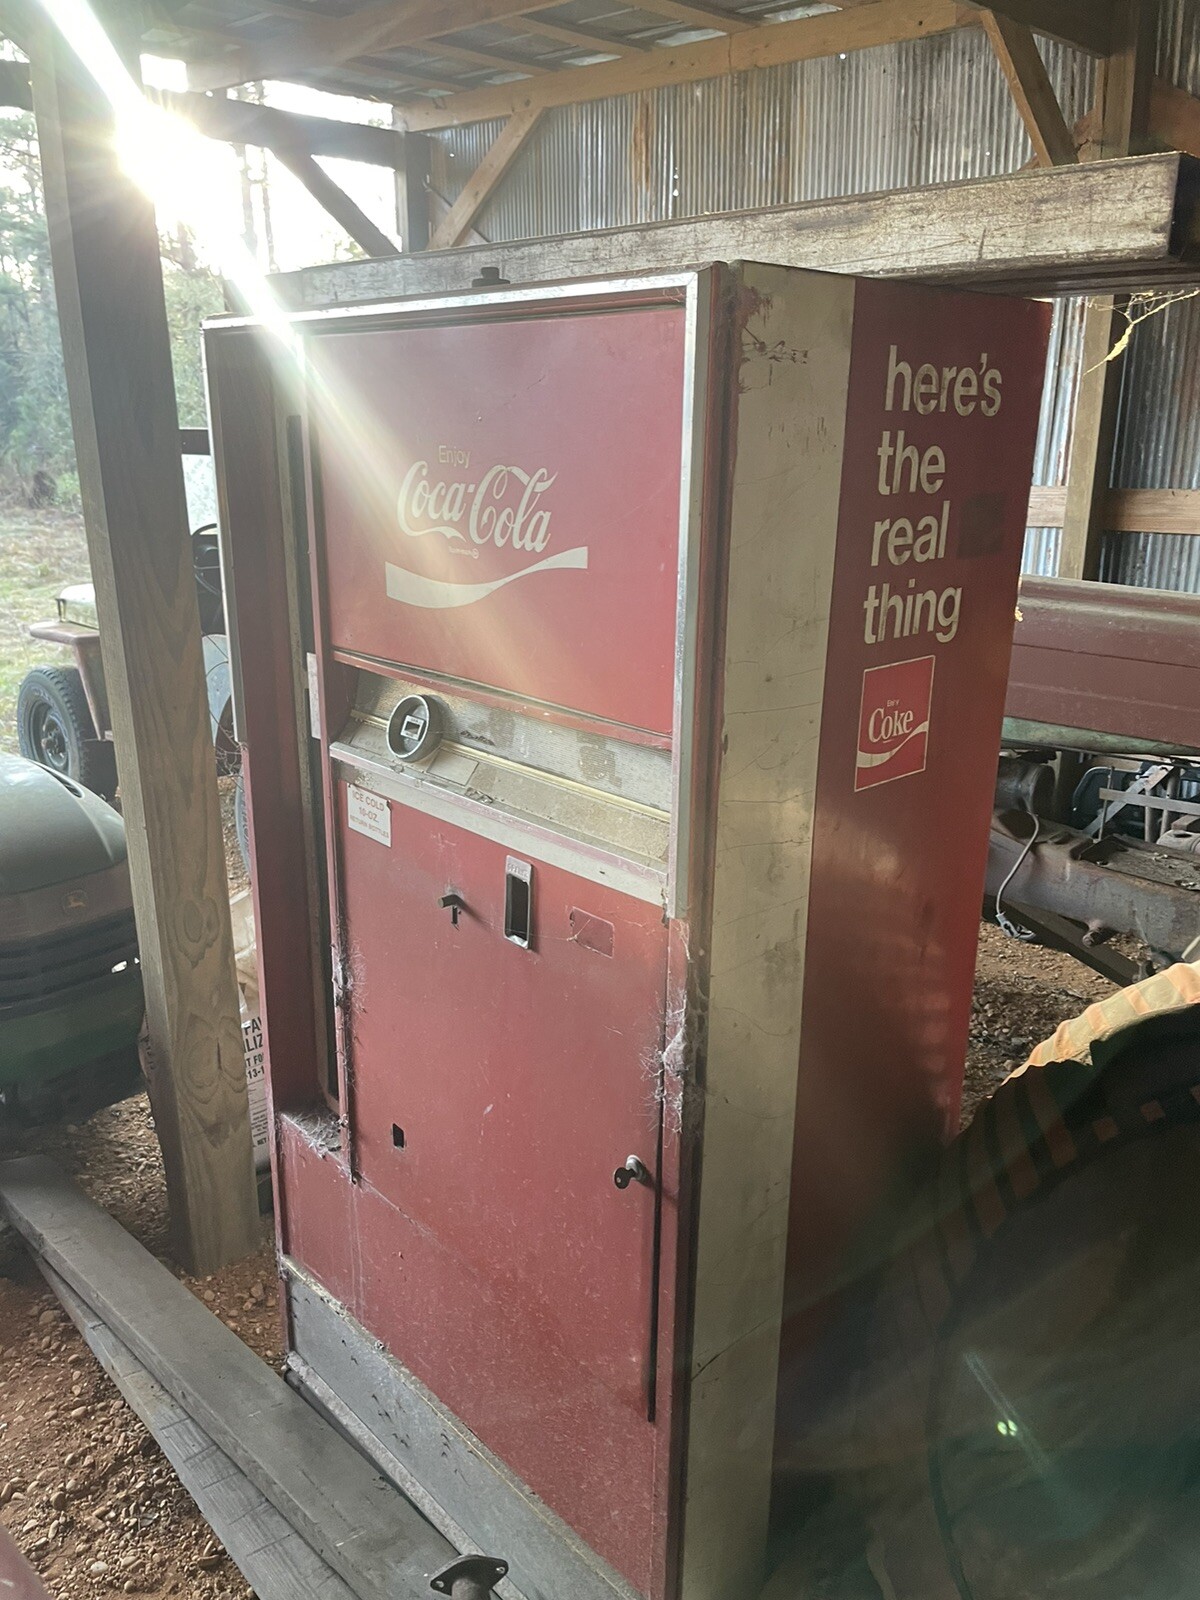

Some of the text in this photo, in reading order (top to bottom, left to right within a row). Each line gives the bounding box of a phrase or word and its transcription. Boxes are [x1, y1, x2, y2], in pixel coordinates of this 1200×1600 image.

[884, 344, 1003, 417] here's
[438, 445, 472, 468] Enjoy
[877, 429, 946, 496] the
[397, 460, 559, 553] Coca-Cola
[870, 500, 951, 567] real
[863, 578, 963, 645] thing
[868, 707, 914, 743] Coke
[352, 789, 385, 812] ICE COLD
[243, 1033, 263, 1053] LIZ
